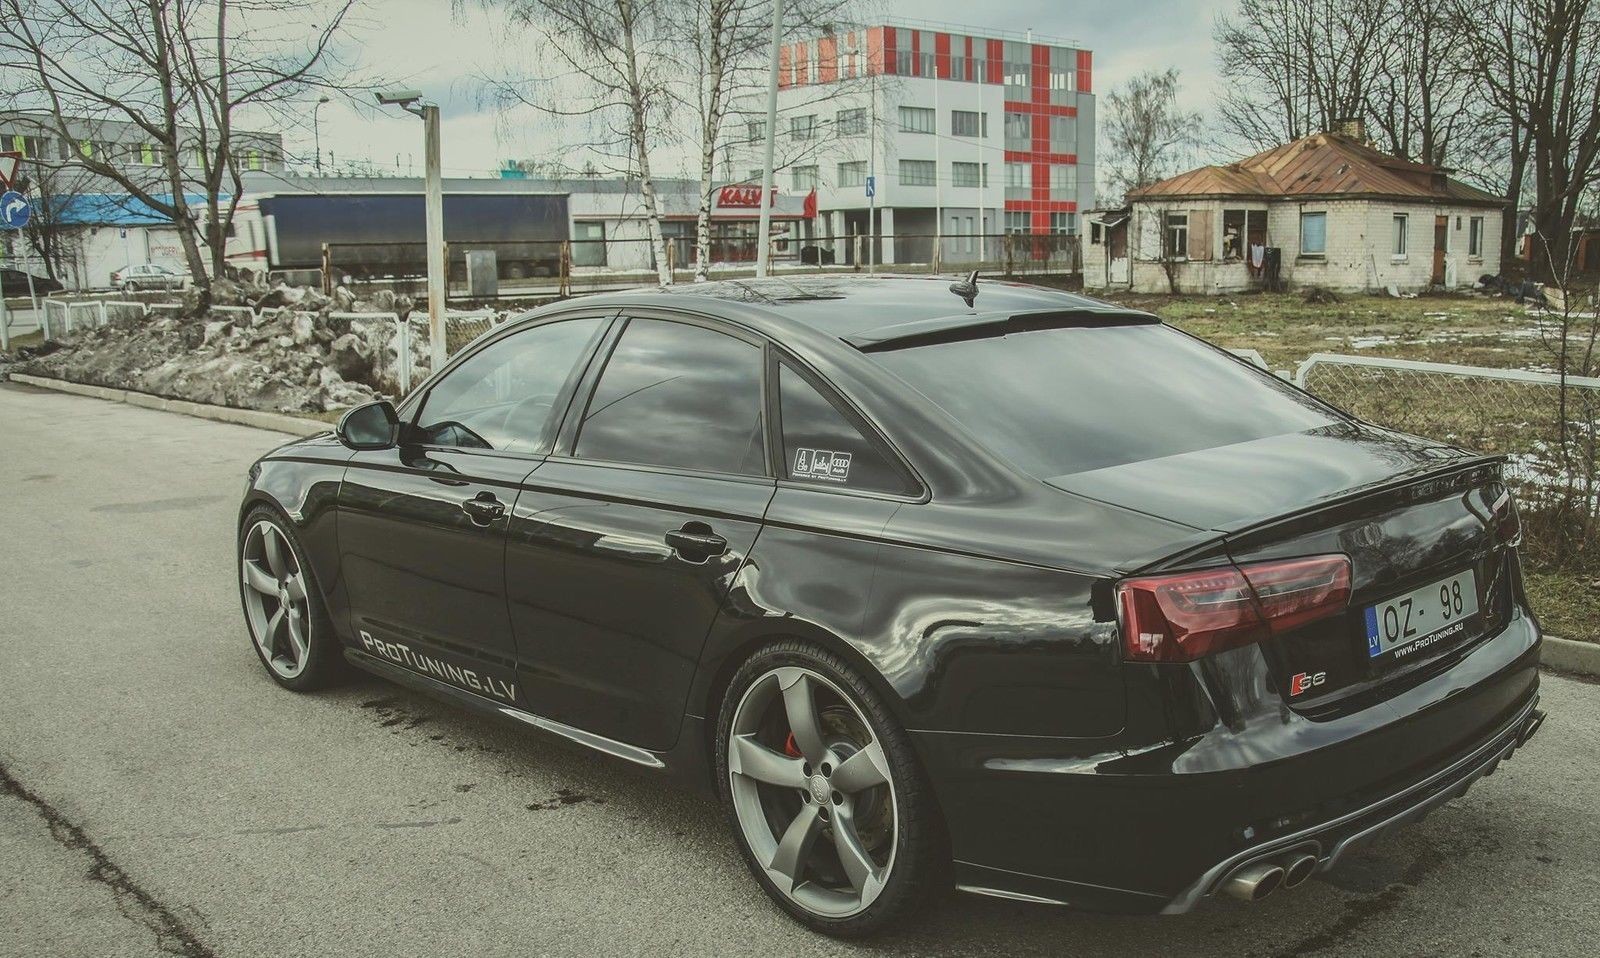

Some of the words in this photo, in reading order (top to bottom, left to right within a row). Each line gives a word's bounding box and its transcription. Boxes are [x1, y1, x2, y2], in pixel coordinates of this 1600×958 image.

[1440, 580, 1463, 620] 98
[1368, 635, 1379, 649] LV
[1298, 671, 1326, 690] S6
